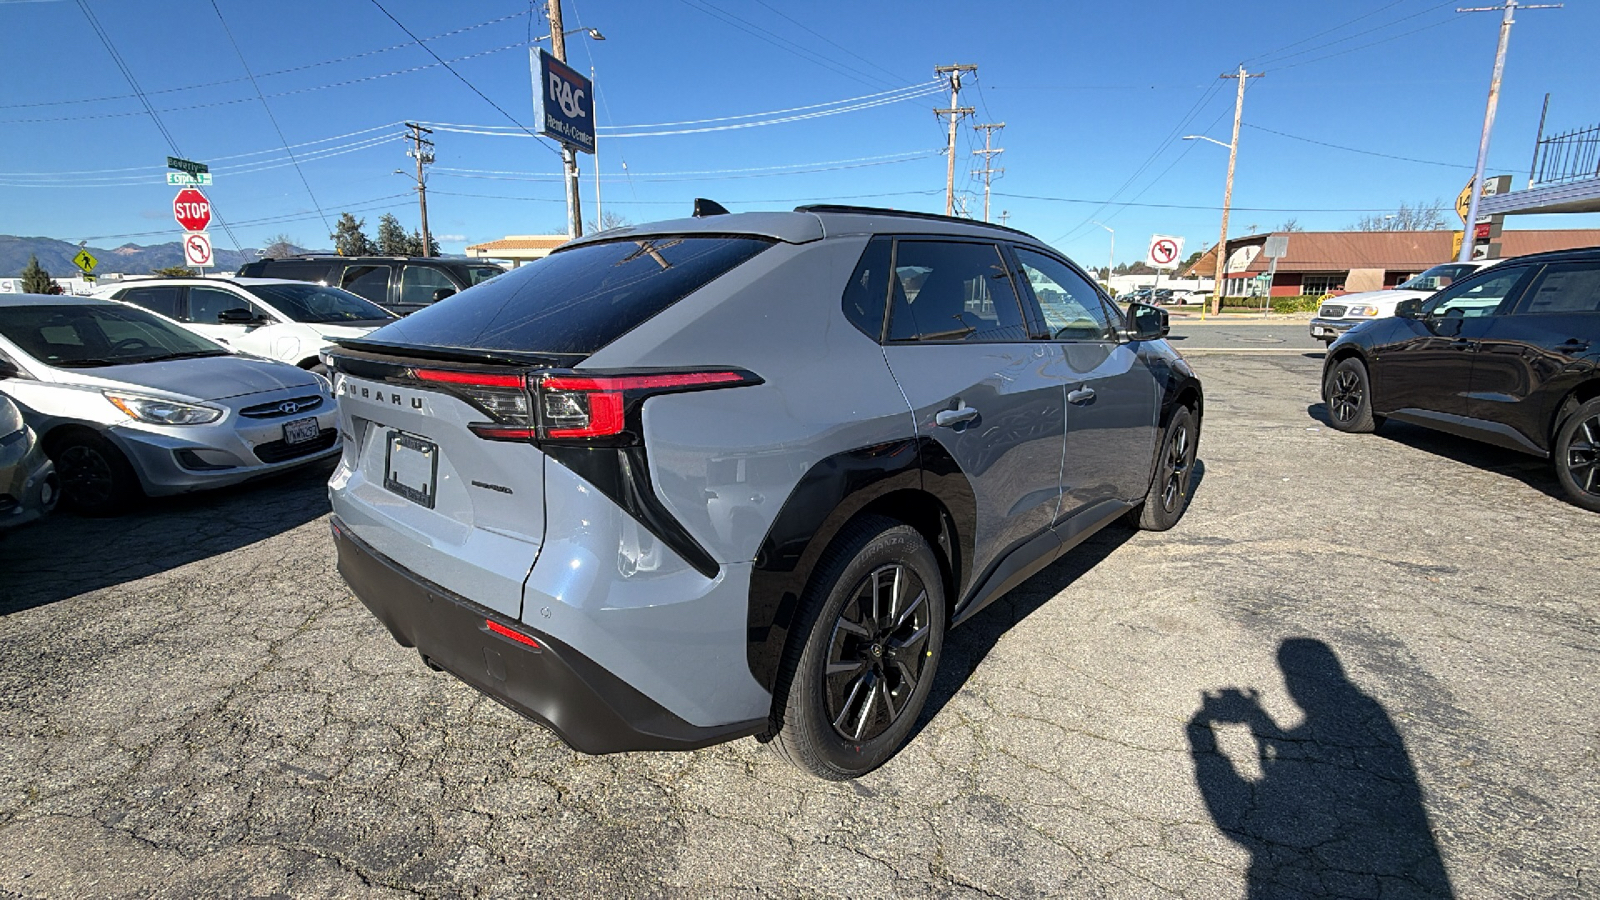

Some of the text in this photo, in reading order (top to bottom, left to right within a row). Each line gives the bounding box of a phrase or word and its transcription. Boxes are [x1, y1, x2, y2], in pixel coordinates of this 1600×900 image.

[549, 72, 585, 118] RAC
[168, 159, 198, 173] Beverly
[173, 174, 201, 184] Cyprs
[176, 202, 208, 219] STOP
[341, 381, 422, 409] SUBARU
[853, 537, 904, 567] TURANZA
